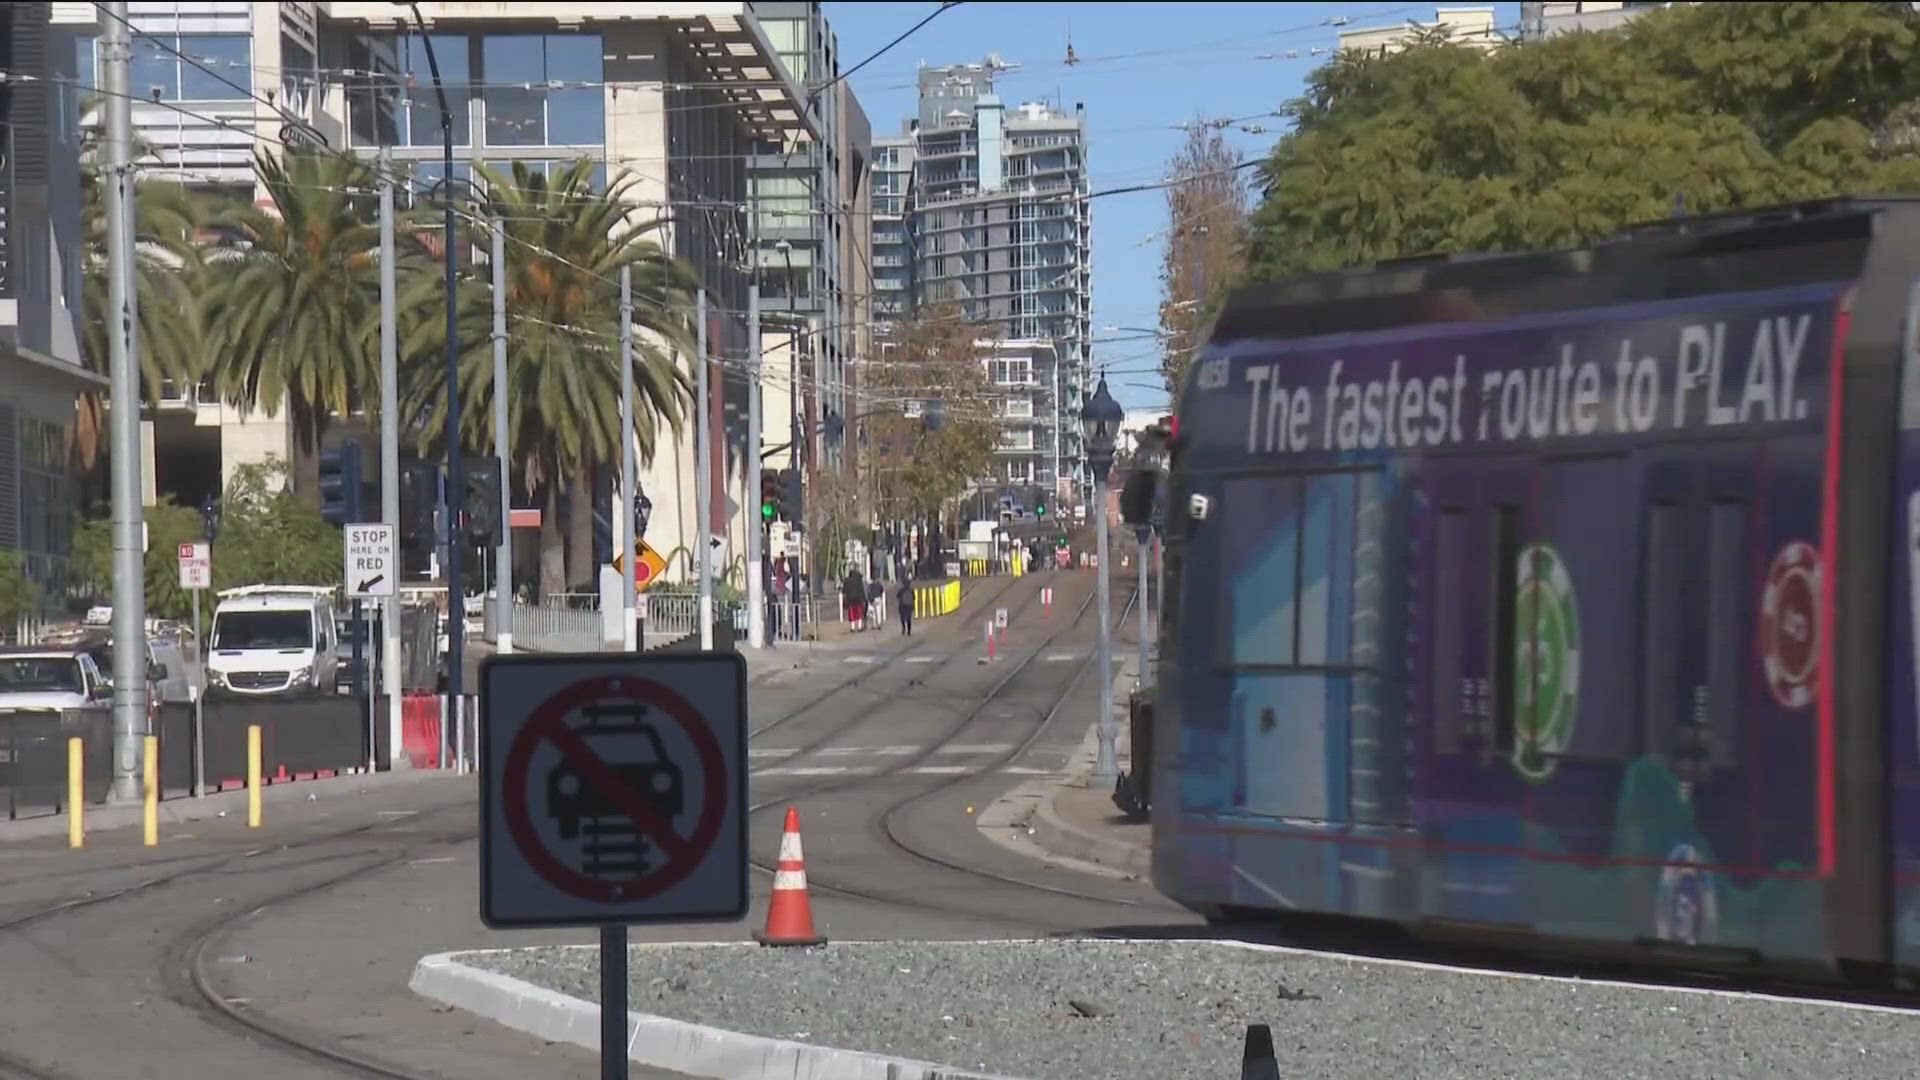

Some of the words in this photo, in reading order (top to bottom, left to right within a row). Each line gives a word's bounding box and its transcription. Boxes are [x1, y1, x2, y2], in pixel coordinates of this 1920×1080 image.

[1245, 363, 1312, 453] The
[1323, 354, 1468, 452] fastest
[1478, 343, 1601, 441] route
[1615, 338, 1659, 433] to
[1673, 314, 1812, 429] PLAY.
[352, 531, 388, 543] STOP
[350, 546, 373, 554] HERE
[378, 546, 390, 554] ON
[357, 558, 383, 570] RED
